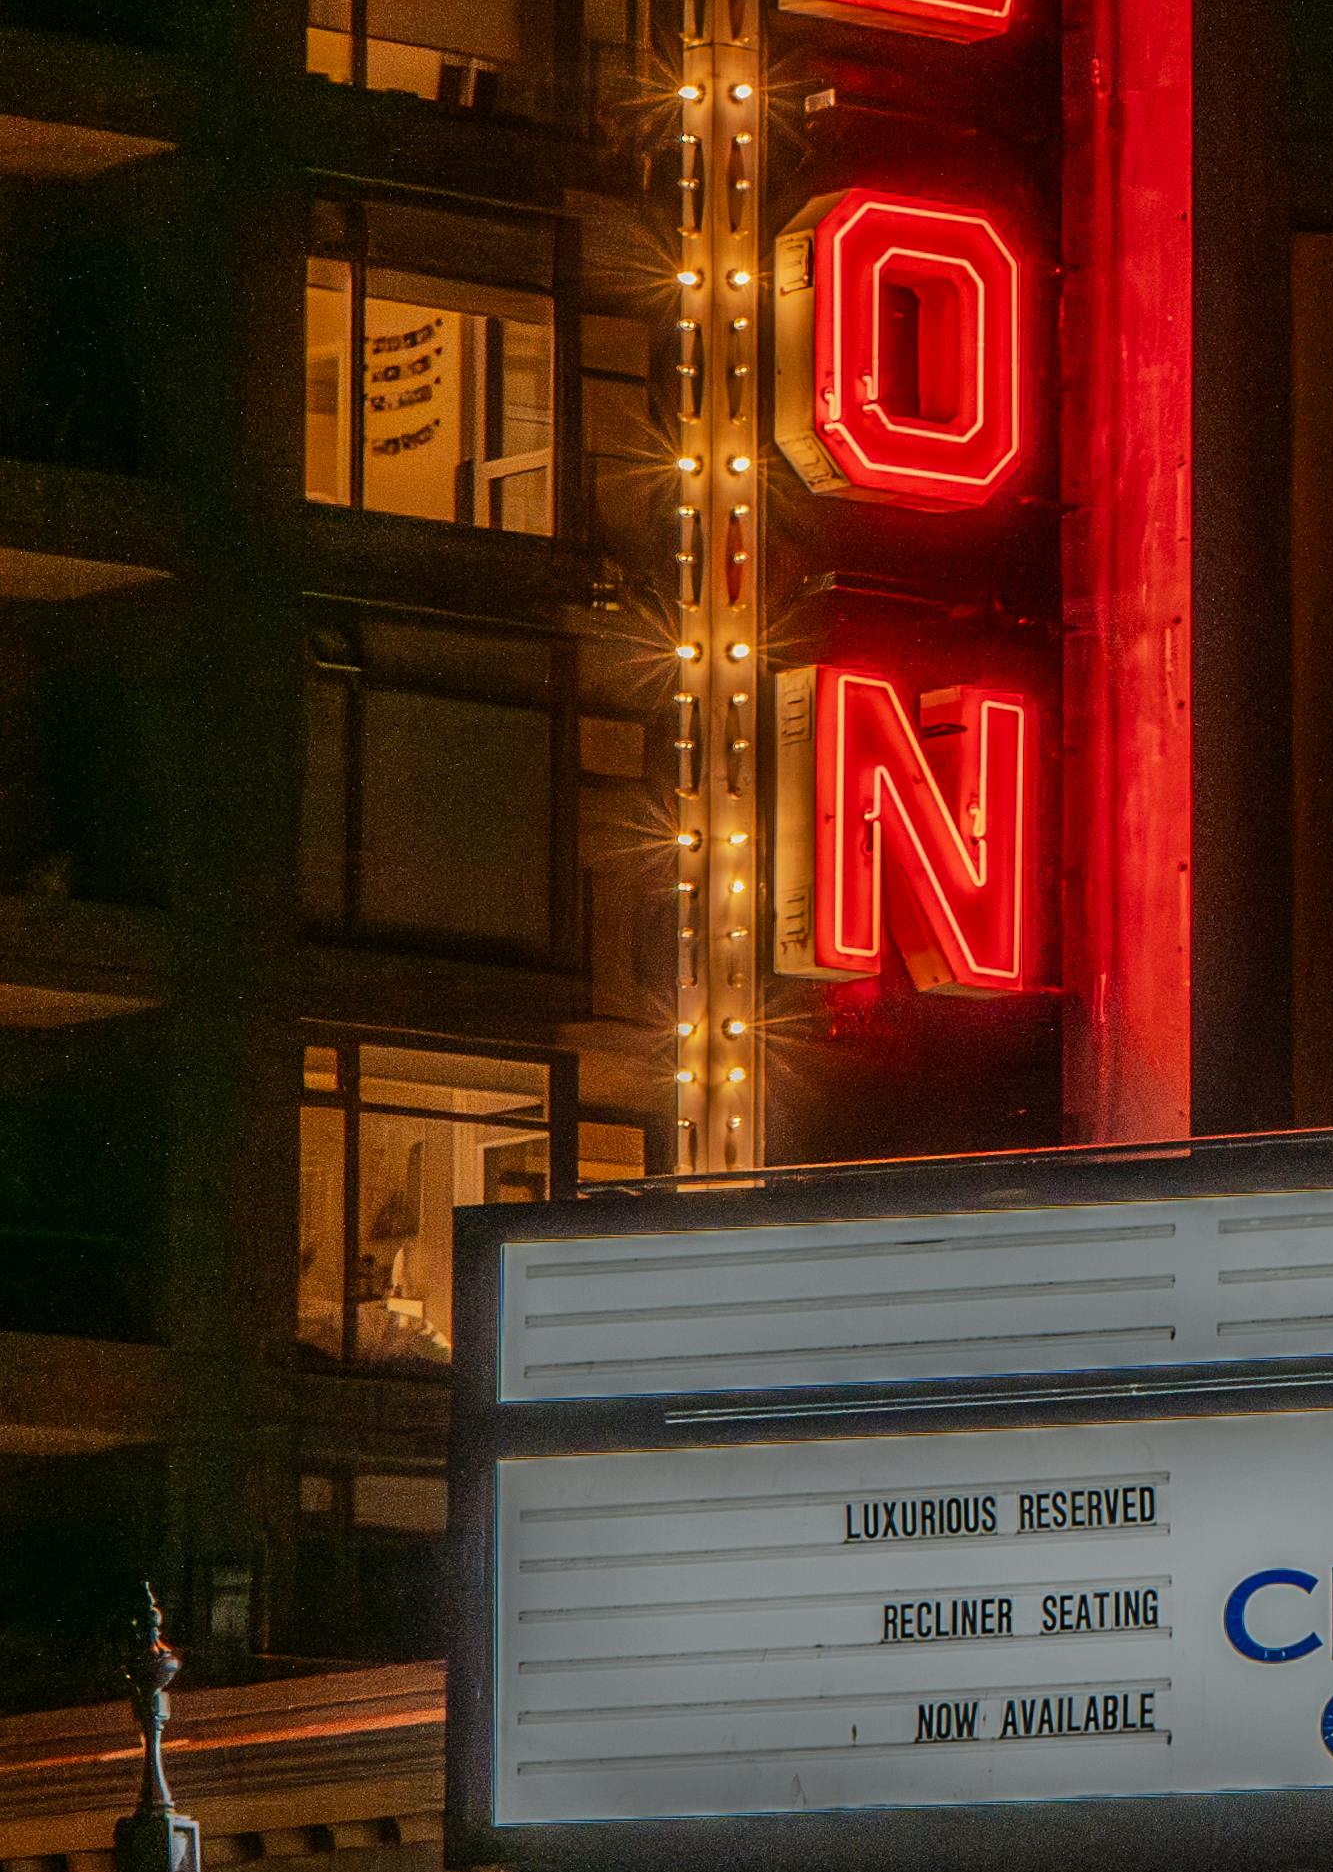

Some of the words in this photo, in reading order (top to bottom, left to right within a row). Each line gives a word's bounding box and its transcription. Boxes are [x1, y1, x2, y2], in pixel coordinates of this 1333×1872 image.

[845, 1497, 997, 1540] LUXURIOUS
[1018, 1487, 1156, 1529] RESERVED
[882, 1599, 1012, 1641] RECLINER
[1042, 1591, 1158, 1631] SEATING
[917, 1703, 977, 1740] NOW
[1002, 1695, 1155, 1735] AVAILABLE
